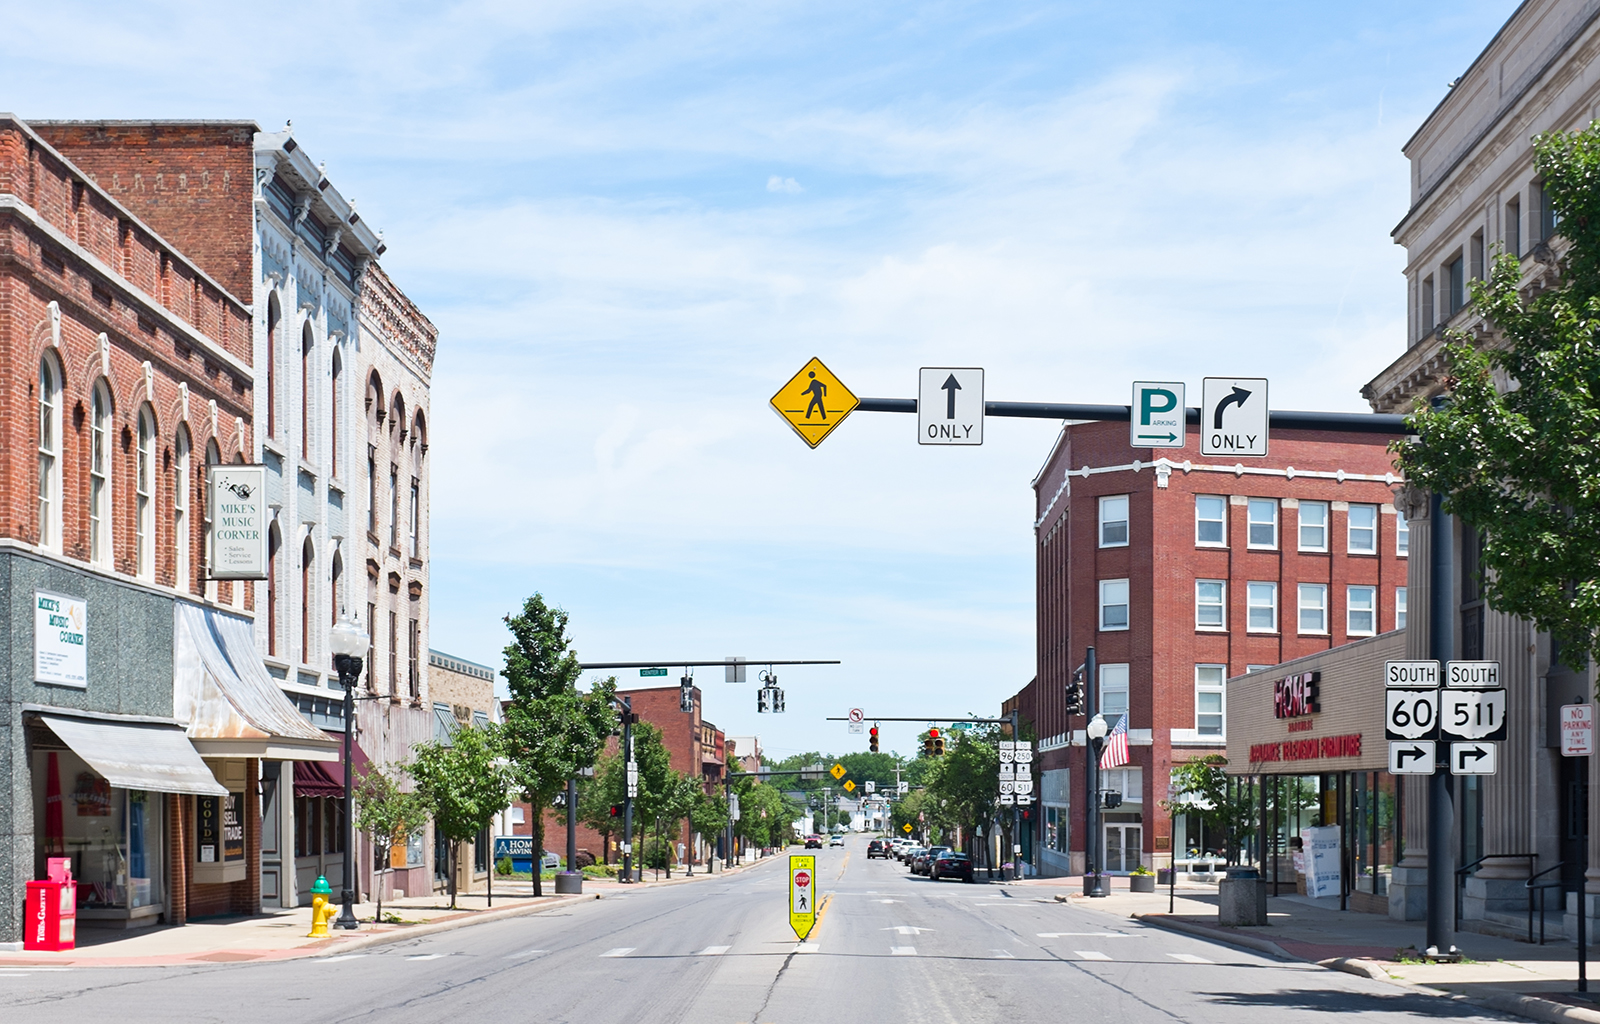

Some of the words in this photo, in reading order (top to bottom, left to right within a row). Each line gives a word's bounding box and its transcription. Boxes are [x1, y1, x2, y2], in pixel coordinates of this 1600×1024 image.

[928, 424, 973, 439] ONLY
[1211, 434, 1257, 449] ONLY
[220, 504, 256, 515] MIKE'S
[222, 517, 255, 528] MUSIC
[217, 530, 260, 541] CORNER
[38, 597, 60, 612] MIKE'S
[49, 614, 69, 629] MUSIC
[59, 631, 84, 646] CORNER
[1390, 666, 1435, 682] SOUTH
[1451, 666, 1497, 682] SOUTH
[1274, 672, 1321, 719] HOME
[1392, 699, 1432, 727] 60
[1454, 703, 1494, 726] 511
[1571, 710, 1584, 719] NO
[1563, 720, 1592, 730] PARKING
[1250, 743, 1280, 763] APPLIANCE
[1281, 739, 1319, 761] TELEVISION
[1320, 733, 1362, 759] FURNITURE
[1001, 752, 1012, 760] 96
[1001, 783, 1012, 791] 60
[224, 796, 236, 810] BUY
[224, 812, 238, 825] SELL
[224, 826, 243, 841] TRADE
[510, 840, 533, 849] HOM
